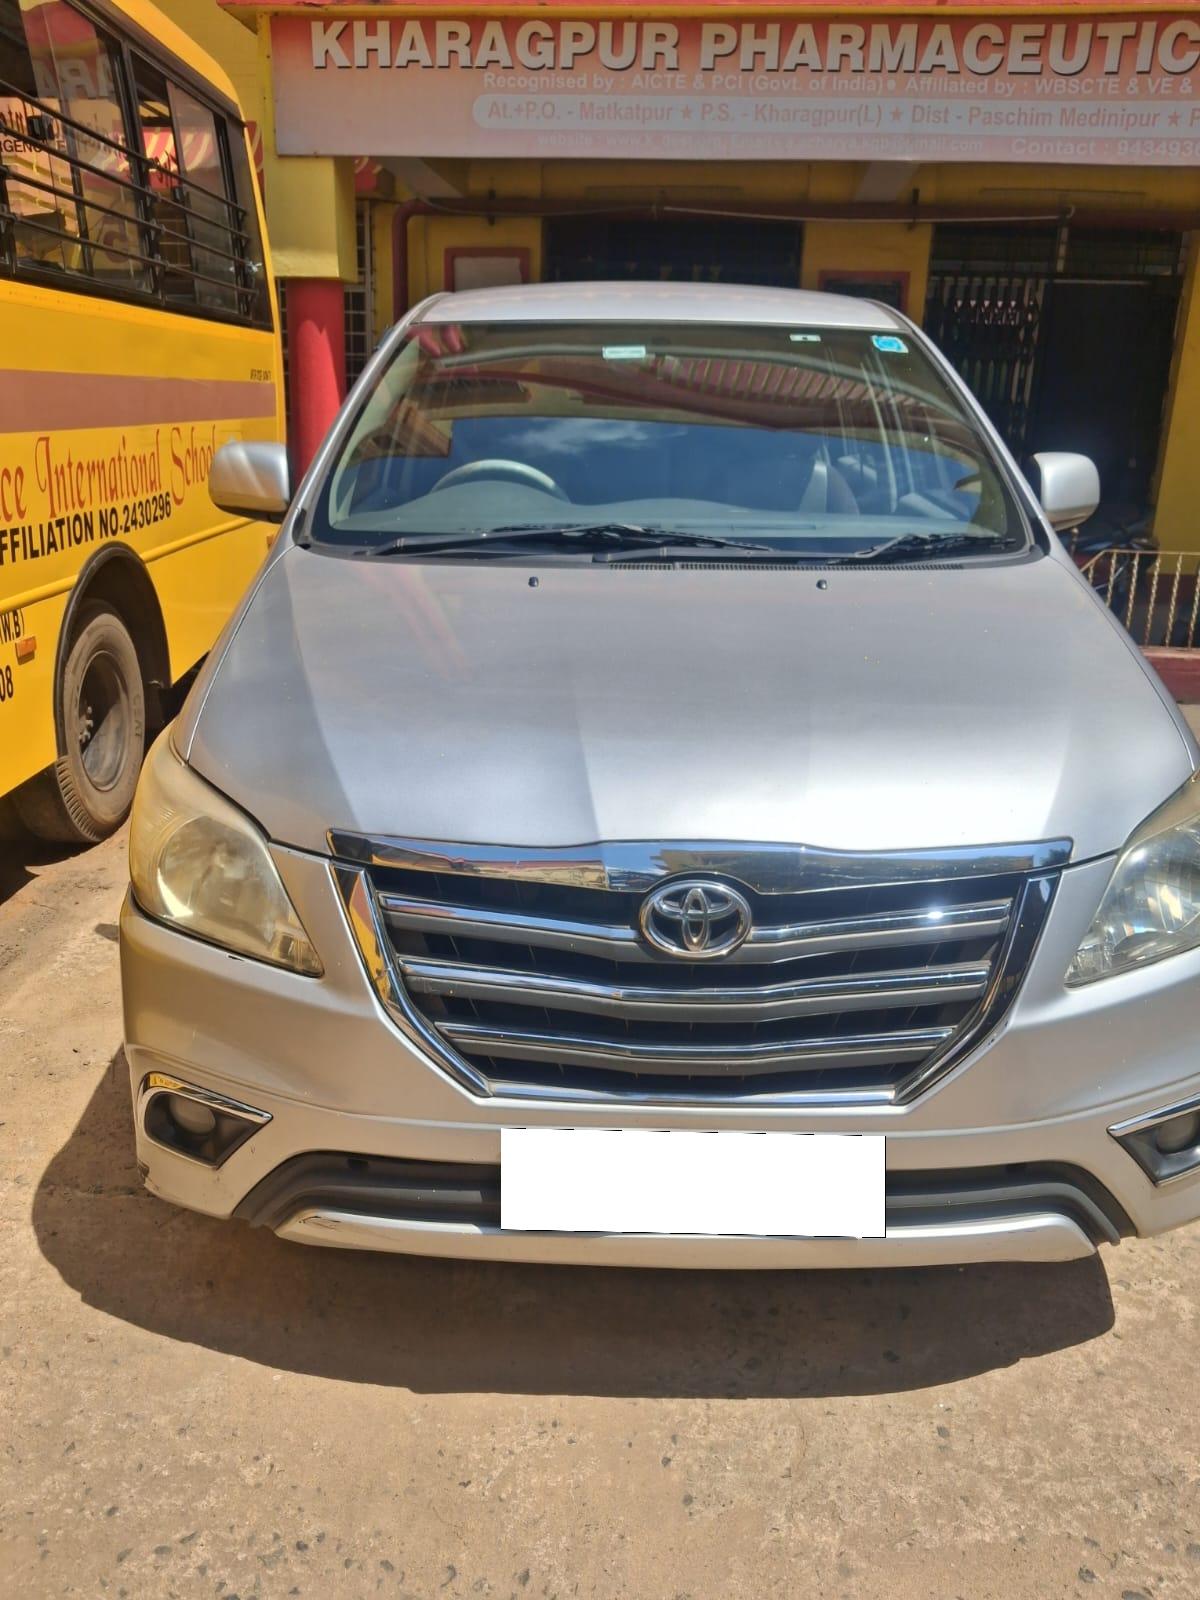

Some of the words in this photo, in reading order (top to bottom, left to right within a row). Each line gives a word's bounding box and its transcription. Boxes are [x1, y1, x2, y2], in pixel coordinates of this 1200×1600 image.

[311, 20, 678, 70] KHARAGPUR
[701, 20, 1200, 76] PHARMACEUTIC
[483, 71, 588, 92] Recognised
[593, 72, 615, 92] by
[631, 73, 687, 89] AICTE
[692, 73, 705, 90] &
[712, 74, 742, 90] PCI
[809, 74, 828, 91] of
[832, 74, 883, 94] India)
[905, 74, 988, 94] Affiliated
[994, 77, 1016, 97] by
[1035, 78, 1120, 95] WBSCTE
[1126, 78, 1140, 95] &
[1147, 77, 1174, 95] VE
[1179, 76, 1193, 94] &
[579, 101, 673, 124] Matkatpur
[700, 102, 735, 122] P.S.
[753, 103, 882, 127] Kharagpur(L)
[911, 104, 950, 124] Dist
[968, 106, 1052, 126] Paschim
[1059, 106, 1160, 130] Medinipur
[1011, 137, 1096, 156] Contact
[35, 428, 162, 518] International
[170, 423, 215, 506] School
